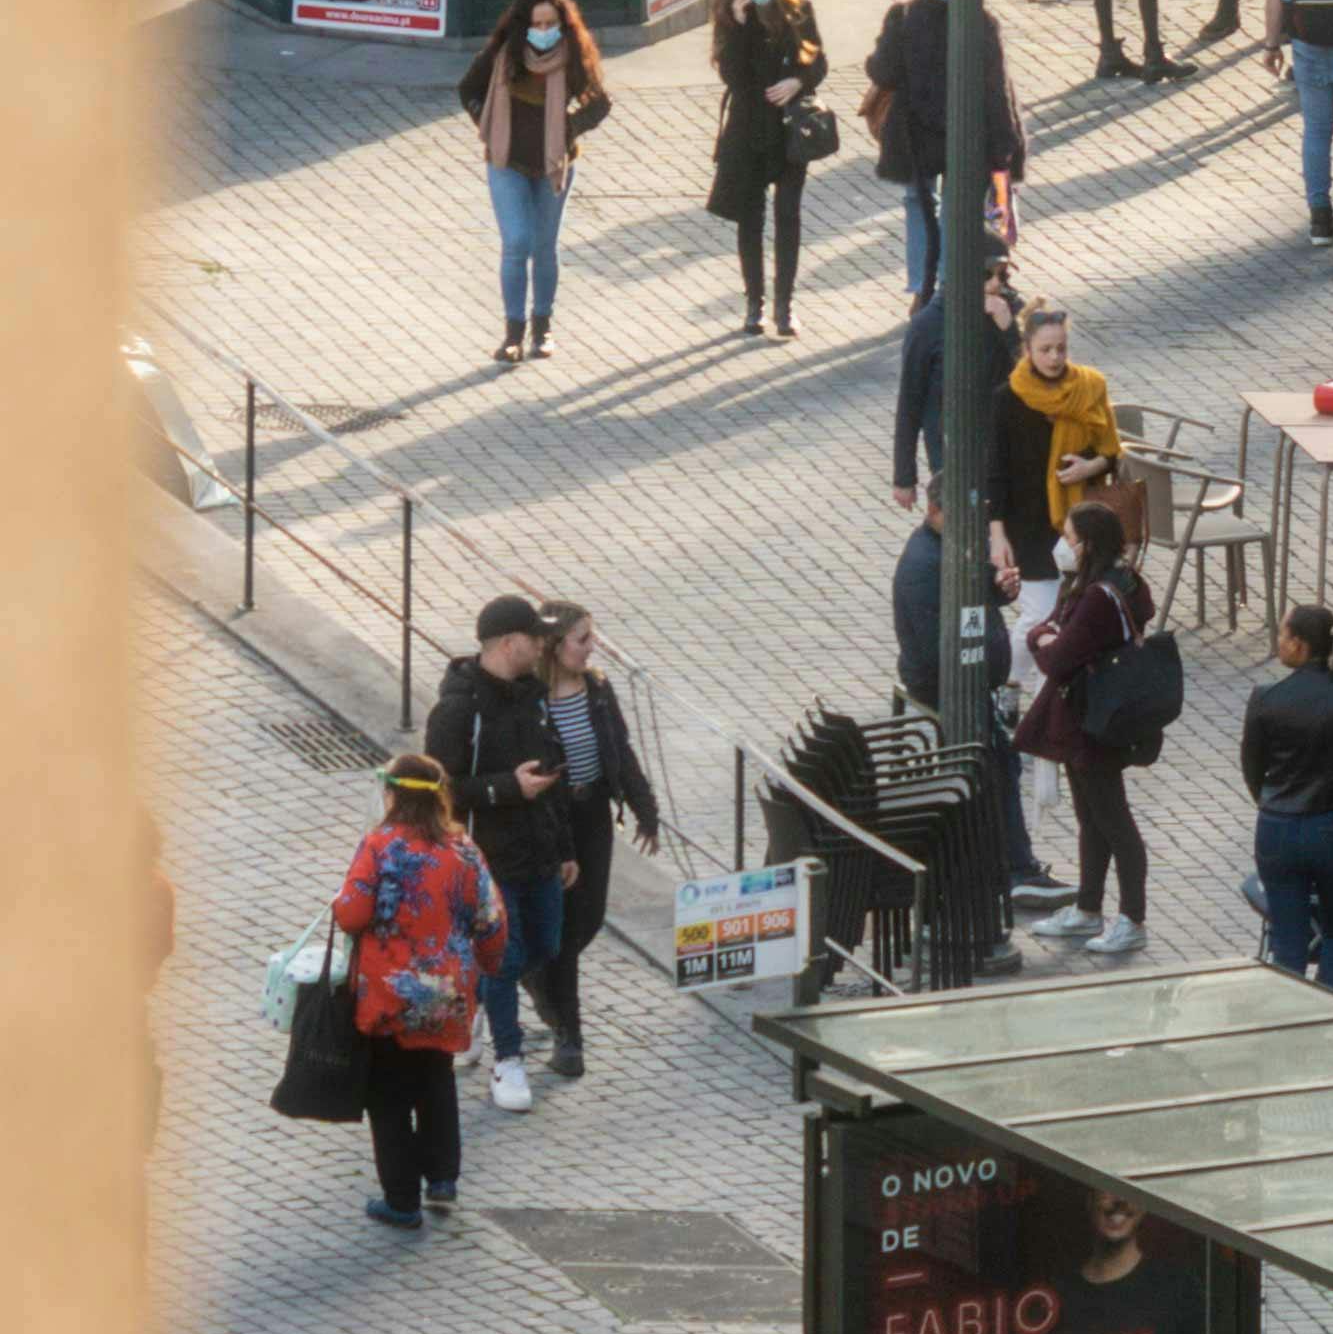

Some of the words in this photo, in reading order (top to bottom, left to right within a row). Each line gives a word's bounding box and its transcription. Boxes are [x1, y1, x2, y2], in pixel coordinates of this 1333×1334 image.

[682, 926, 711, 944] 500
[721, 919, 750, 937] 901
[762, 912, 790, 930] 906
[683, 957, 708, 976] 1M
[718, 948, 753, 971] 11M
[881, 1174, 902, 1198] O
[912, 1157, 998, 1194] NOVO
[881, 1225, 921, 1253] DE
